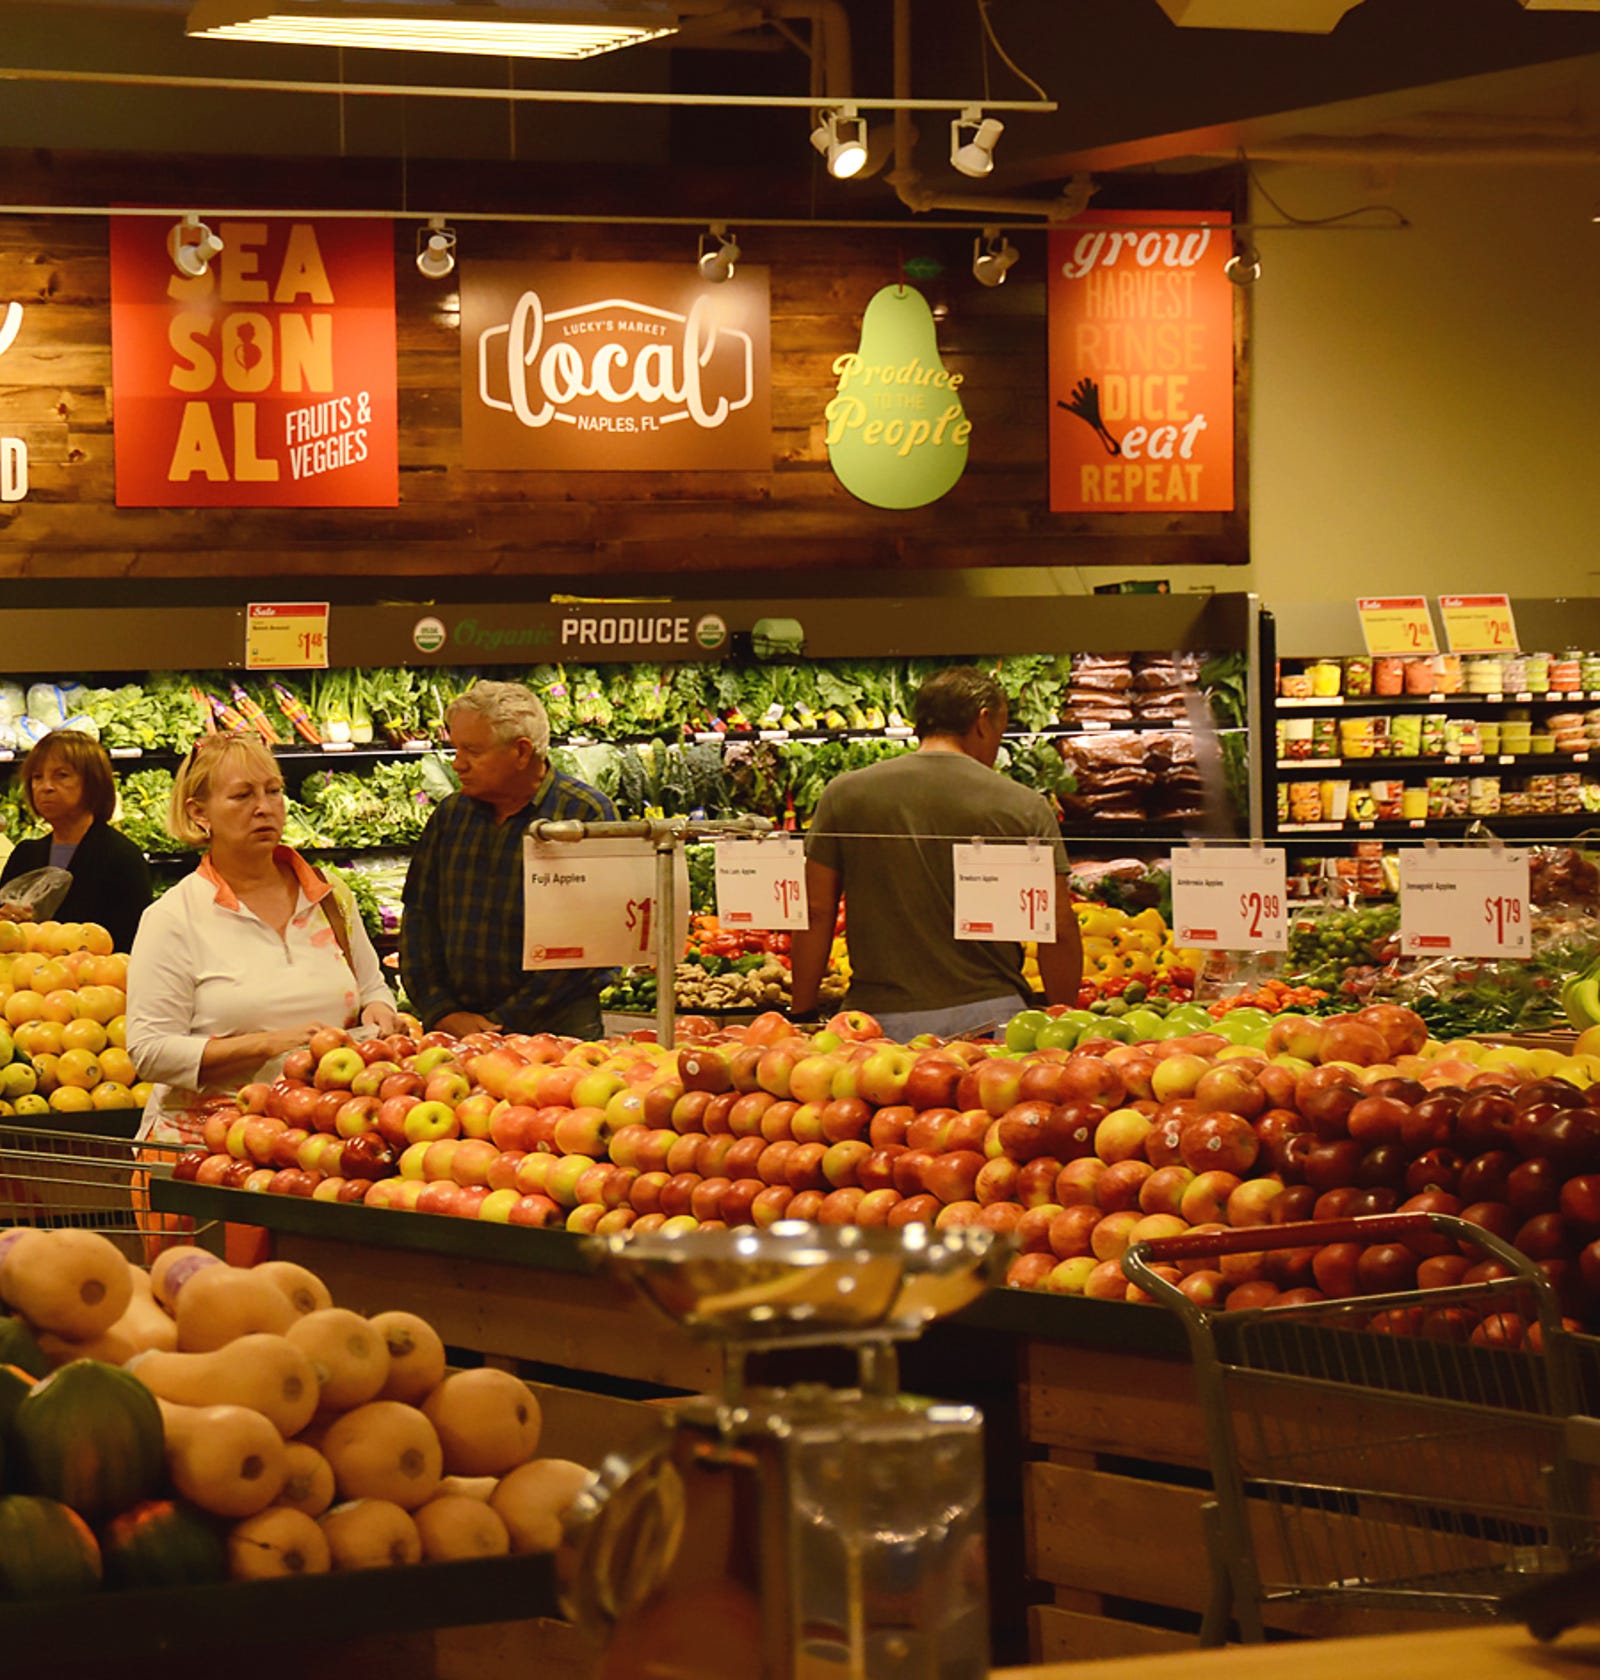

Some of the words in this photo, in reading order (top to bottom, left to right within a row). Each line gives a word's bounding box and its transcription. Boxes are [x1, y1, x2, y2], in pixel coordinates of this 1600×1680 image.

[1062, 222, 1211, 279] grow
[1086, 269, 1197, 320] HARVEST
[168, 312, 334, 393] SON
[563, 320, 614, 337] LUCKY'S
[618, 320, 667, 337] MARKET
[1075, 322, 1208, 371] RINSE
[508, 290, 730, 428] local
[832, 352, 964, 391] Produce
[286, 396, 352, 445] FRUITS
[356, 391, 372, 424] &
[874, 392, 893, 410] TO
[896, 392, 928, 410] THE
[1103, 374, 1190, 421] DICE
[168, 402, 279, 482] AL
[577, 415, 638, 433] NAPLES,
[641, 415, 659, 431] FL
[824, 396, 973, 457] People
[1121, 413, 1208, 460] eat
[290, 428, 368, 480] VEGGIES
[1080, 463, 1203, 503] REPEAT
[454, 618, 558, 652] Organic
[561, 616, 690, 645] PRODUCE
[531, 873, 551, 887] Fuji
[553, 873, 586, 887] Apples
[1240, 892, 1280, 938] $299
[1484, 896, 1521, 945] $179
